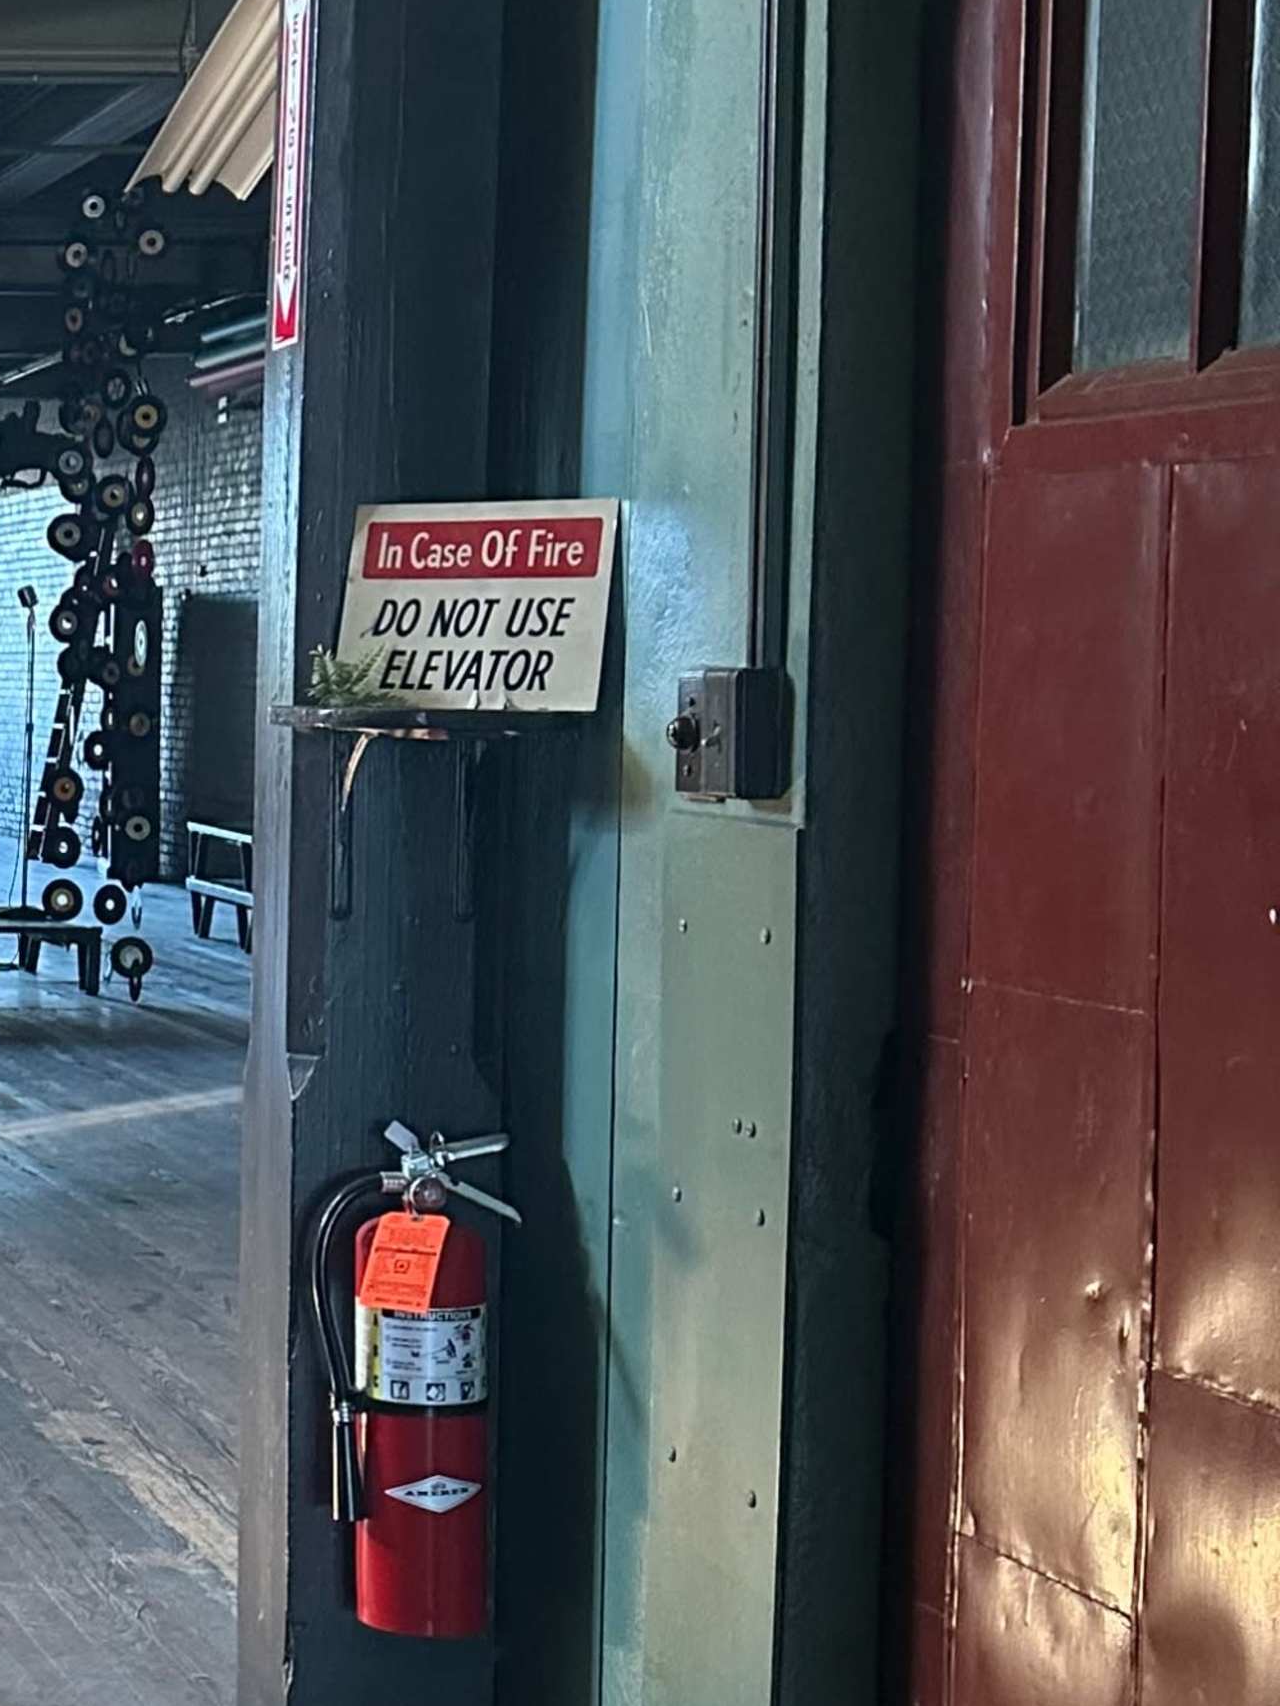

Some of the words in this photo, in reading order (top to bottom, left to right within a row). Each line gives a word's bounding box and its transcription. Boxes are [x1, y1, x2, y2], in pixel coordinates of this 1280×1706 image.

[378, 532, 403, 569] In
[410, 532, 472, 569] Case
[481, 529, 522, 567] Of
[527, 529, 584, 567] Fire
[371, 598, 421, 637] DO
[427, 598, 501, 637] NOT
[505, 597, 576, 637] USE
[378, 649, 554, 691] ELEVATOR
